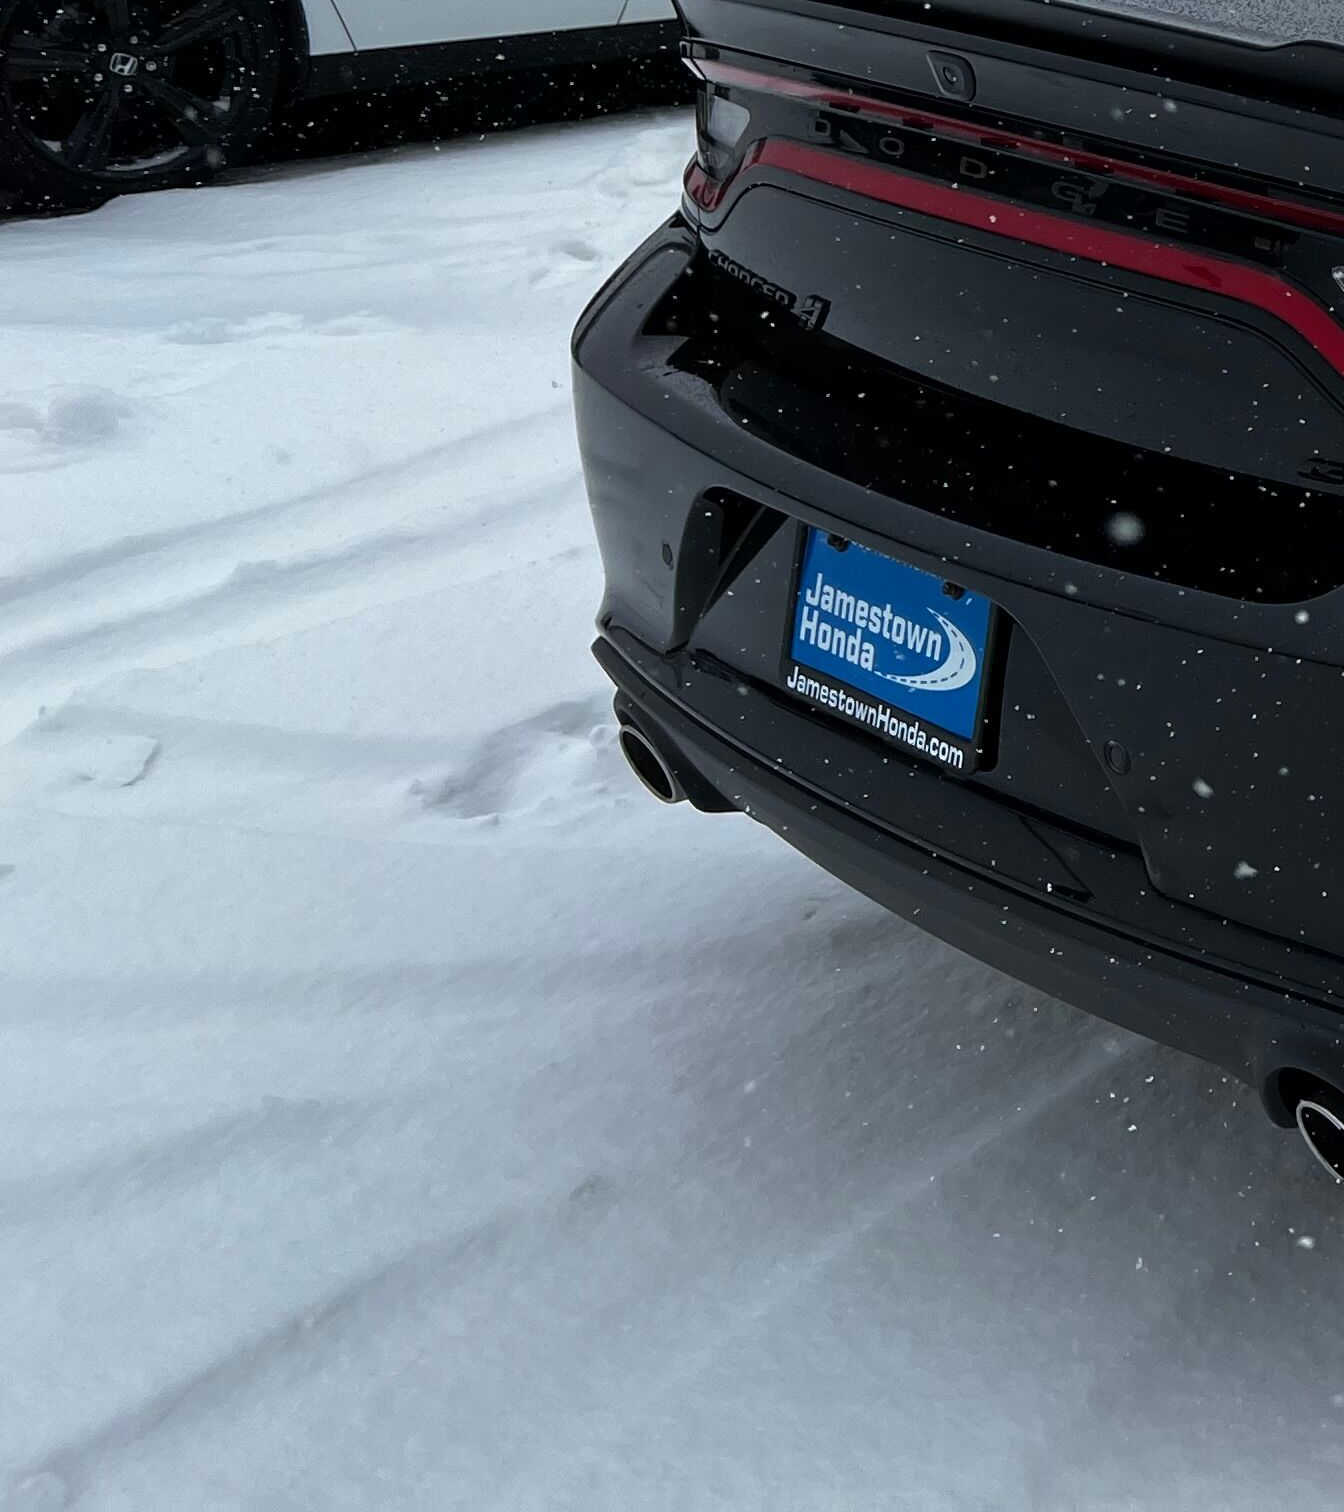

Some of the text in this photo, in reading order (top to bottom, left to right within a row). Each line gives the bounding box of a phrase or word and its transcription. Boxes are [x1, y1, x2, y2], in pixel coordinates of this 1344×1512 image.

[811, 120, 1191, 232] DODGE
[799, 606, 875, 672] Honda
[805, 573, 942, 661] Jamestown
[787, 666, 964, 769] JamestownHonda.com
